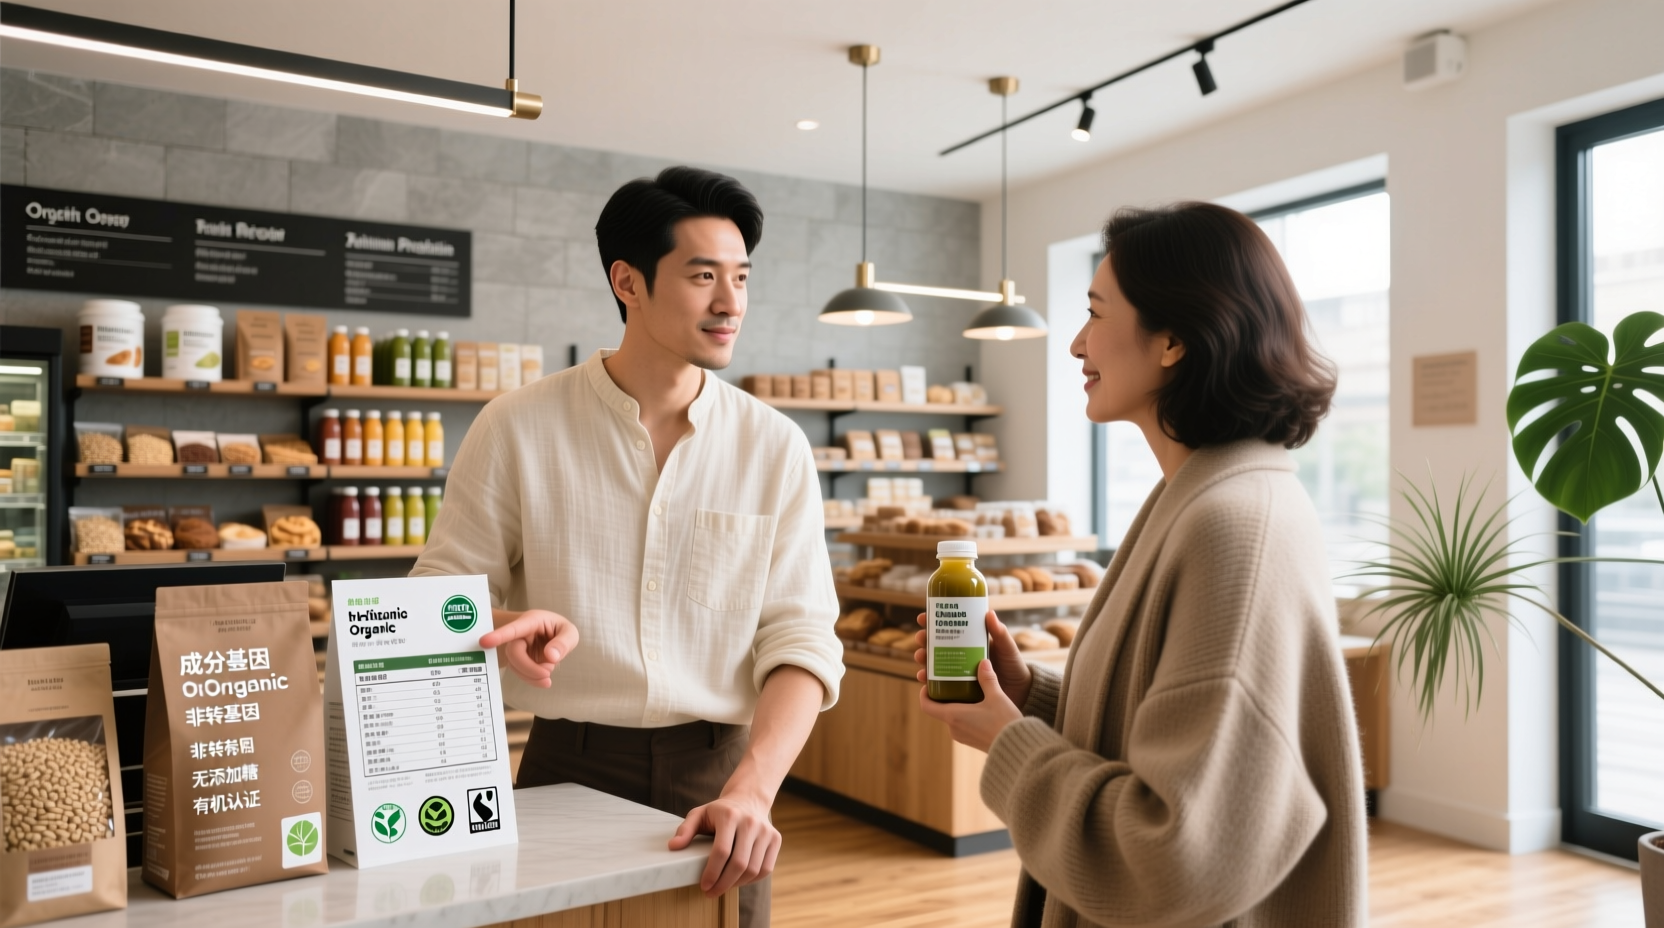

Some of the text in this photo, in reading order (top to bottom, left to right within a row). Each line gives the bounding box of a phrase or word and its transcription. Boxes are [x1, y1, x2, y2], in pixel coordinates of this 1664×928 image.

[180, 647, 271, 676] 成分基因
[185, 703, 260, 727] 非转基因
[193, 790, 262, 816] 有机认证
